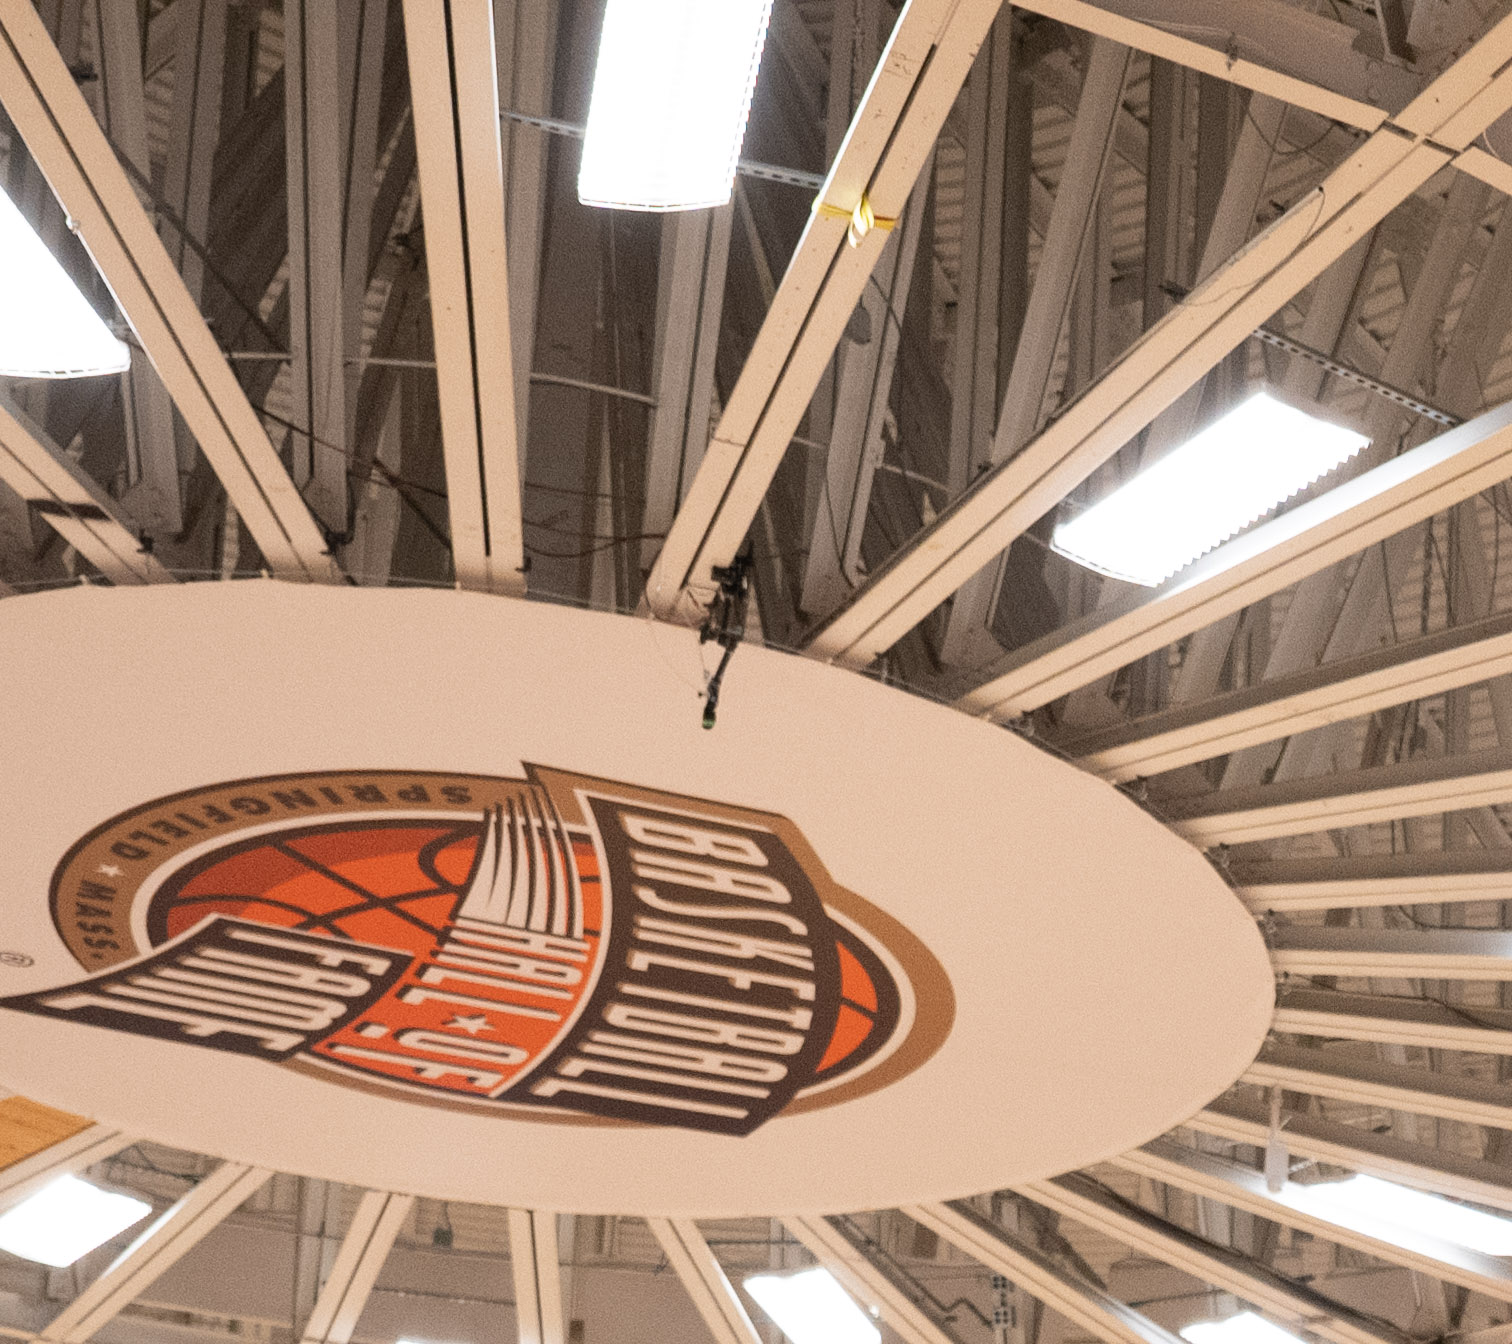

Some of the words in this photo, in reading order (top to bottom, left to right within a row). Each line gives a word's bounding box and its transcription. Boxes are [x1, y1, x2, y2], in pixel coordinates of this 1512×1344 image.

[111, 780, 474, 862] SPRINGFIELD
[40, 926, 392, 1054] FAME
[399, 921, 591, 1024] HALL
[530, 811, 816, 1119] BASKETBALL
[326, 1021, 530, 1090] OF
